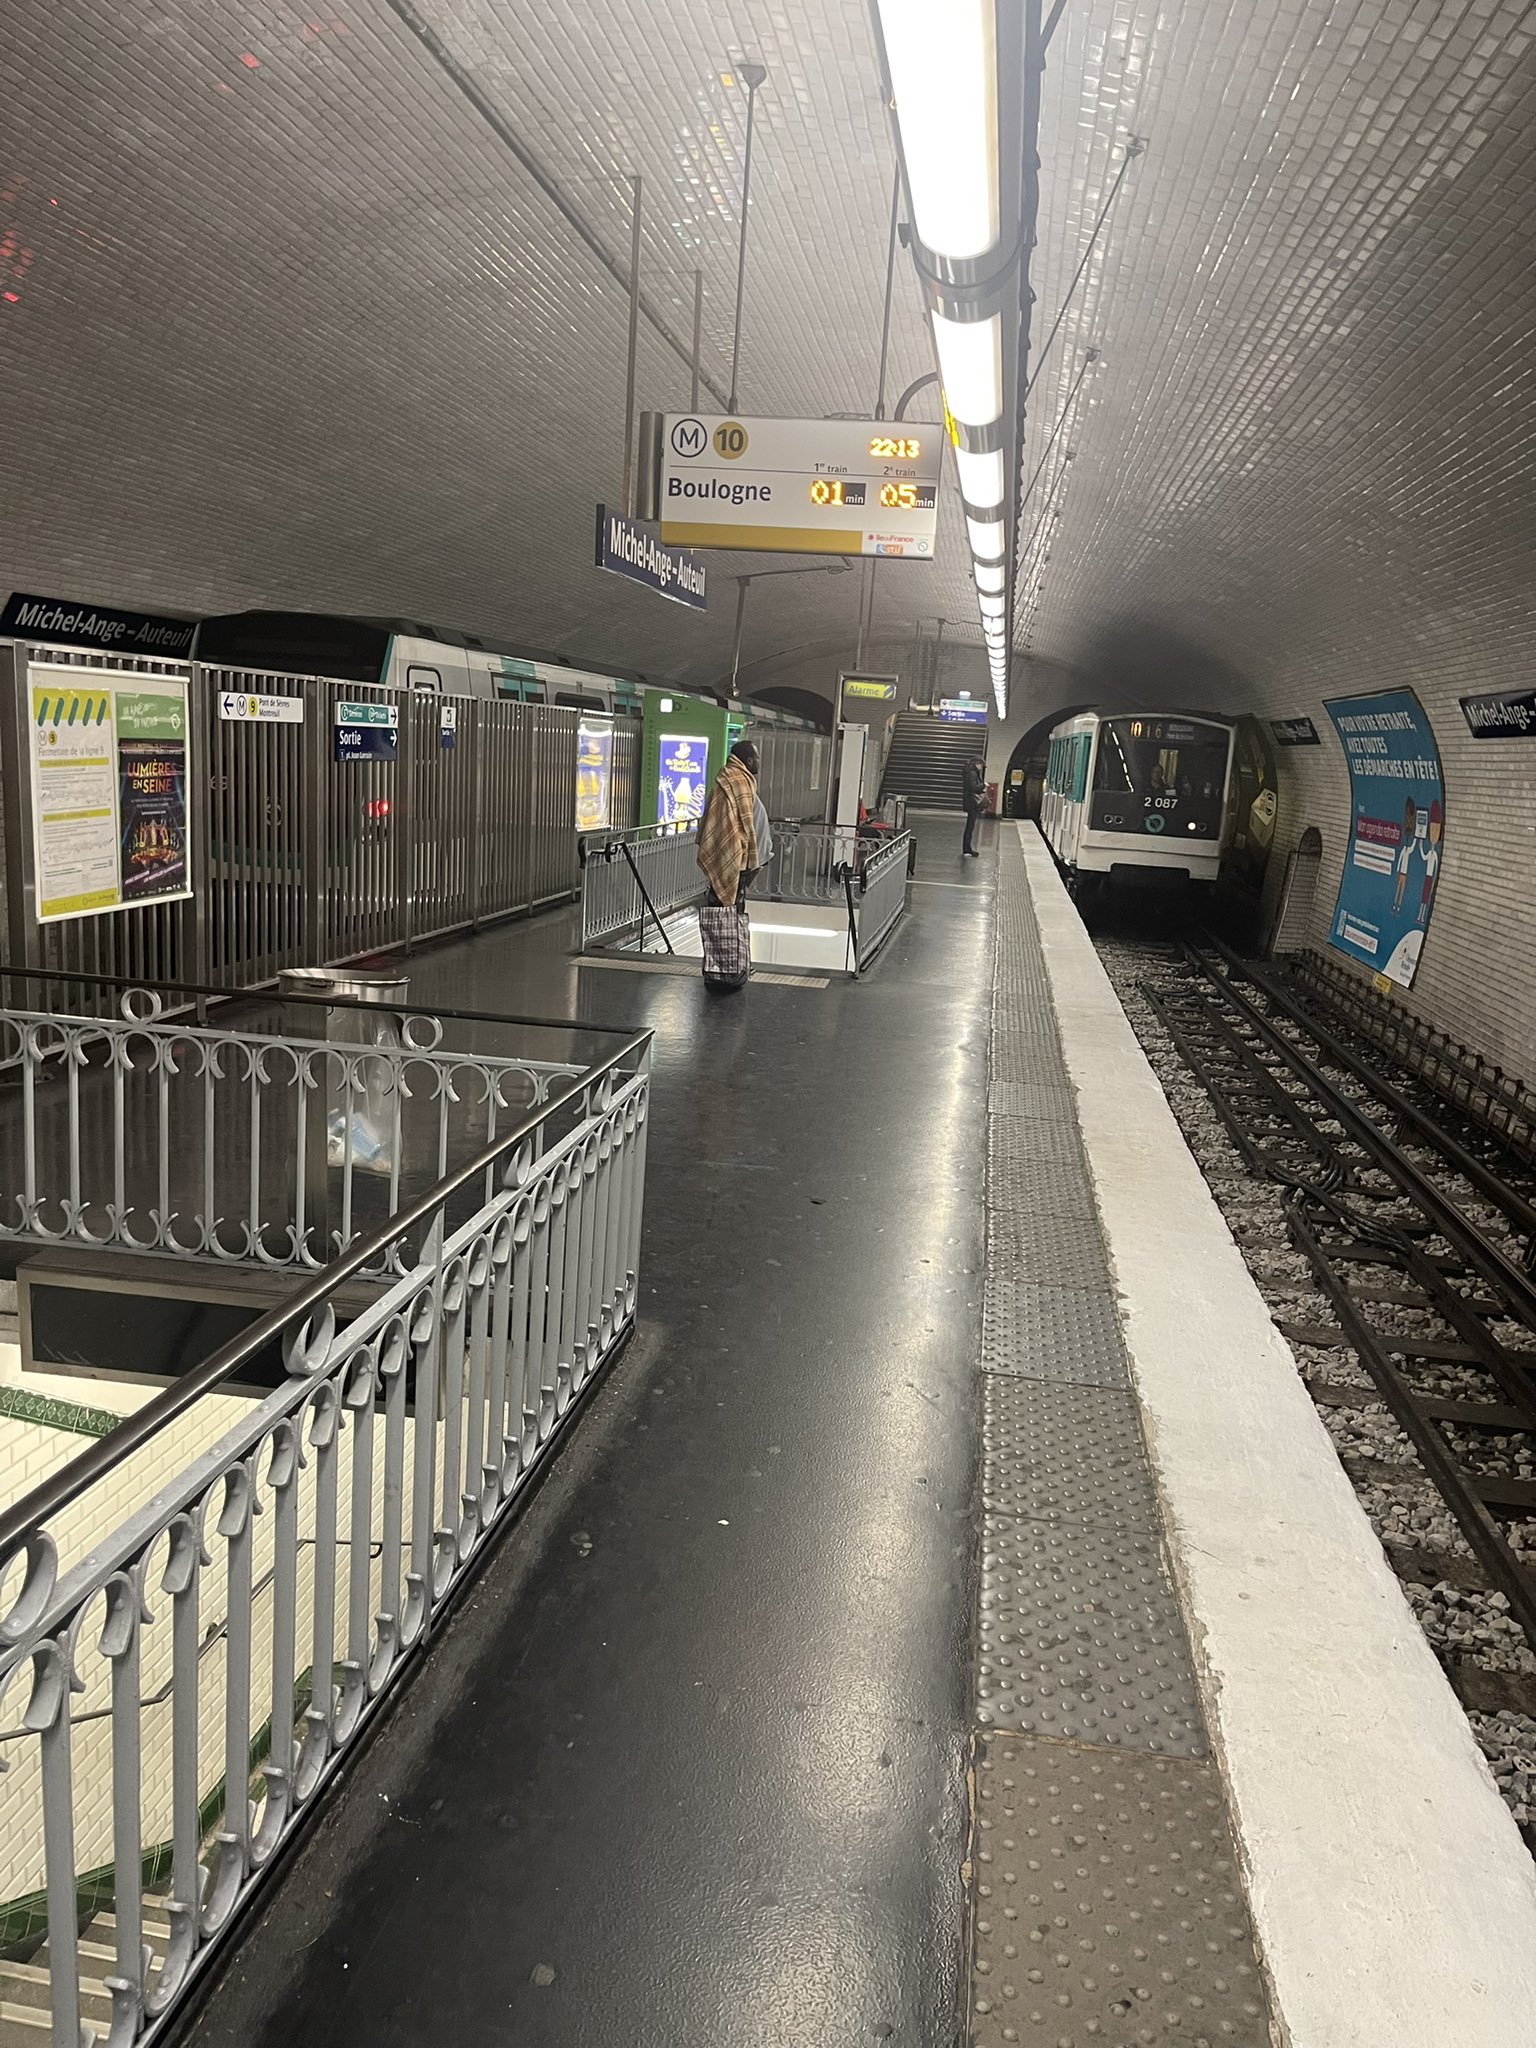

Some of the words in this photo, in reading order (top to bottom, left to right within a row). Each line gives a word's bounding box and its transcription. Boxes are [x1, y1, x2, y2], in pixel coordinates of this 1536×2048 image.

[717, 428, 744, 452] 10
[870, 438, 920, 458] 22:13
[827, 465, 848, 473] train
[895, 468, 916, 476] train
[668, 477, 772, 505] Boulogne
[811, 480, 844, 506] 01
[845, 495, 864, 504] min
[880, 483, 917, 509] 05
[914, 500, 934, 508] min
[610, 517, 672, 586] Michel-Ange
[677, 556, 705, 597] Auteuil
[14, 602, 126, 642] Michel-Ange
[134, 622, 193, 648] Auteuil
[848, 684, 881, 696] Alarme
[1466, 702, 1530, 730] Michel-Ange
[339, 729, 362, 745] Sortie
[1131, 721, 1142, 737] 10
[1361, 737, 1387, 753] TOUTES
[128, 758, 177, 777] LUMIÈRES
[1352, 758, 1364, 775] LES
[1363, 754, 1403, 778] DÉMARCHES
[1403, 760, 1415, 778] EN
[1414, 755, 1435, 779] TÊTE
[133, 780, 142, 789] EN
[143, 779, 172, 793] SEINE
